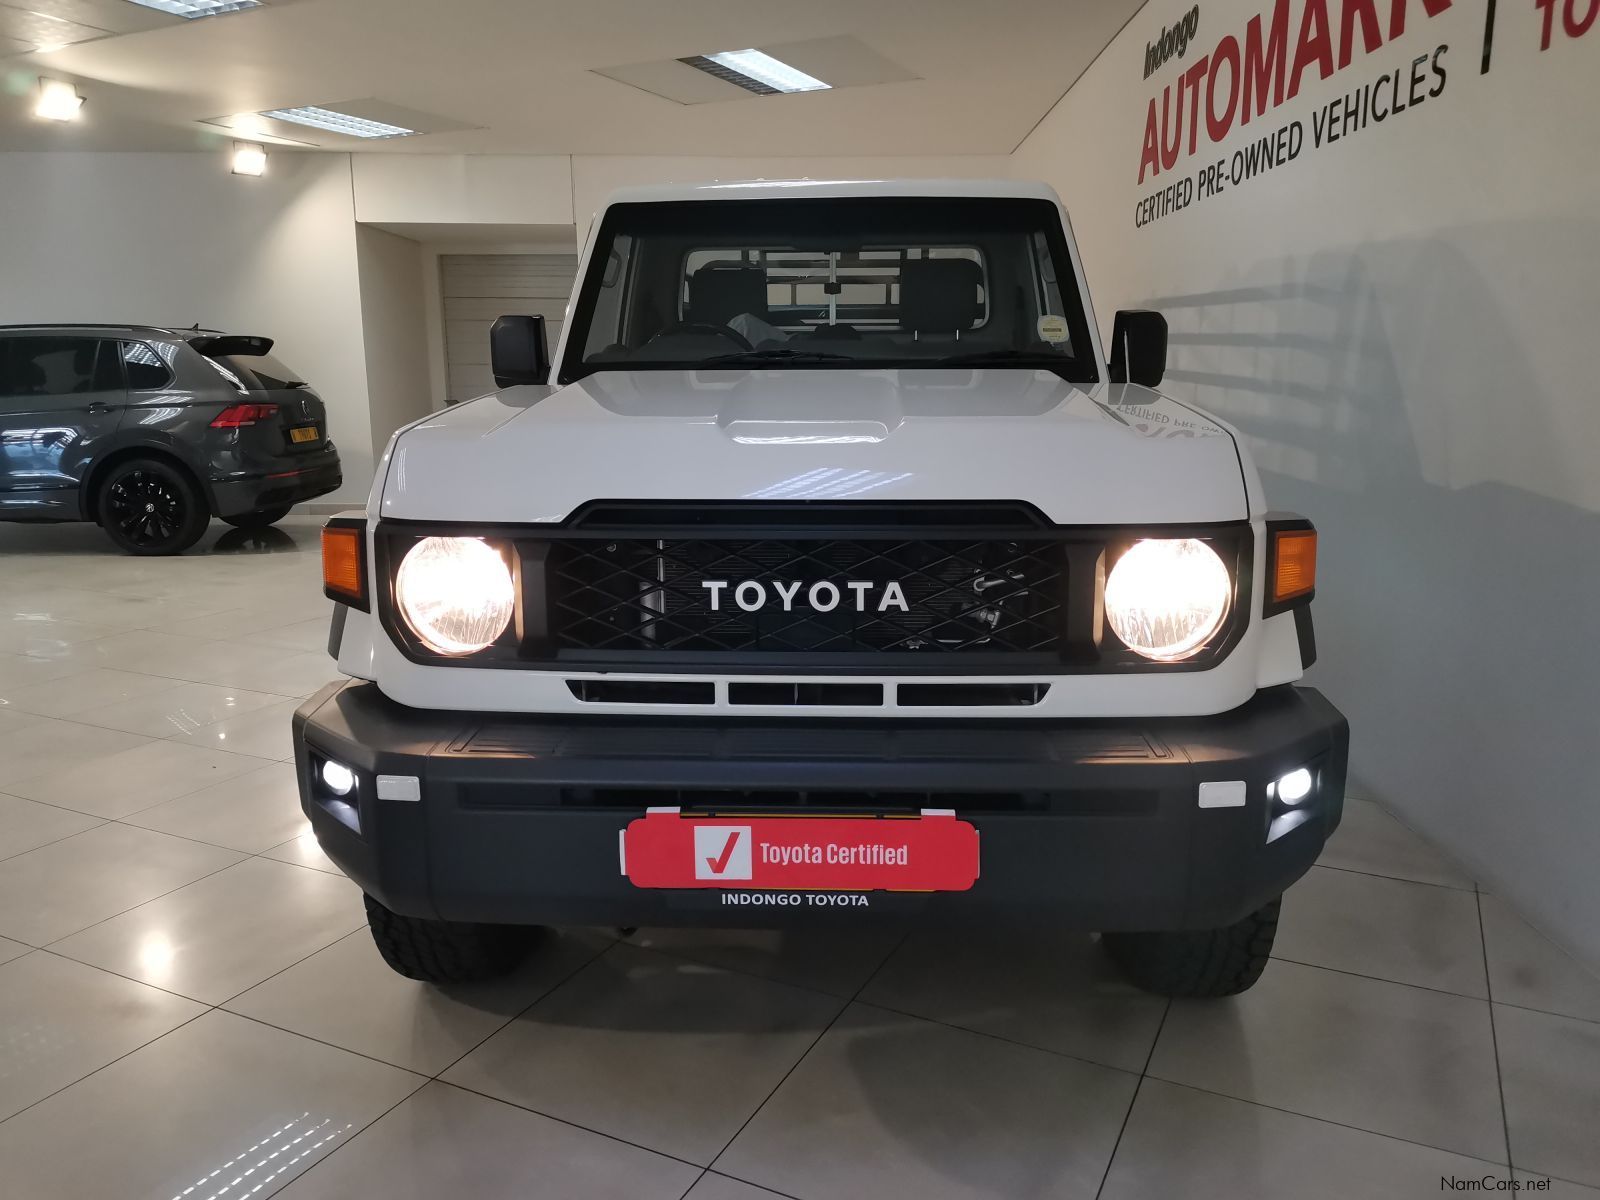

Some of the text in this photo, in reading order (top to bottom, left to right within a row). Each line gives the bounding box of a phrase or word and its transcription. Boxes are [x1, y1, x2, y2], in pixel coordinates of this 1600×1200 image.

[1143, 4, 1199, 80] Indongo
[1135, 44, 1449, 228] CERTIFIED PRE-OWNED VEHICLES
[702, 580, 910, 612] TOYOTA
[760, 843, 908, 865] Toyota Certified
[721, 893, 869, 906] INDONGO TOYOTA
